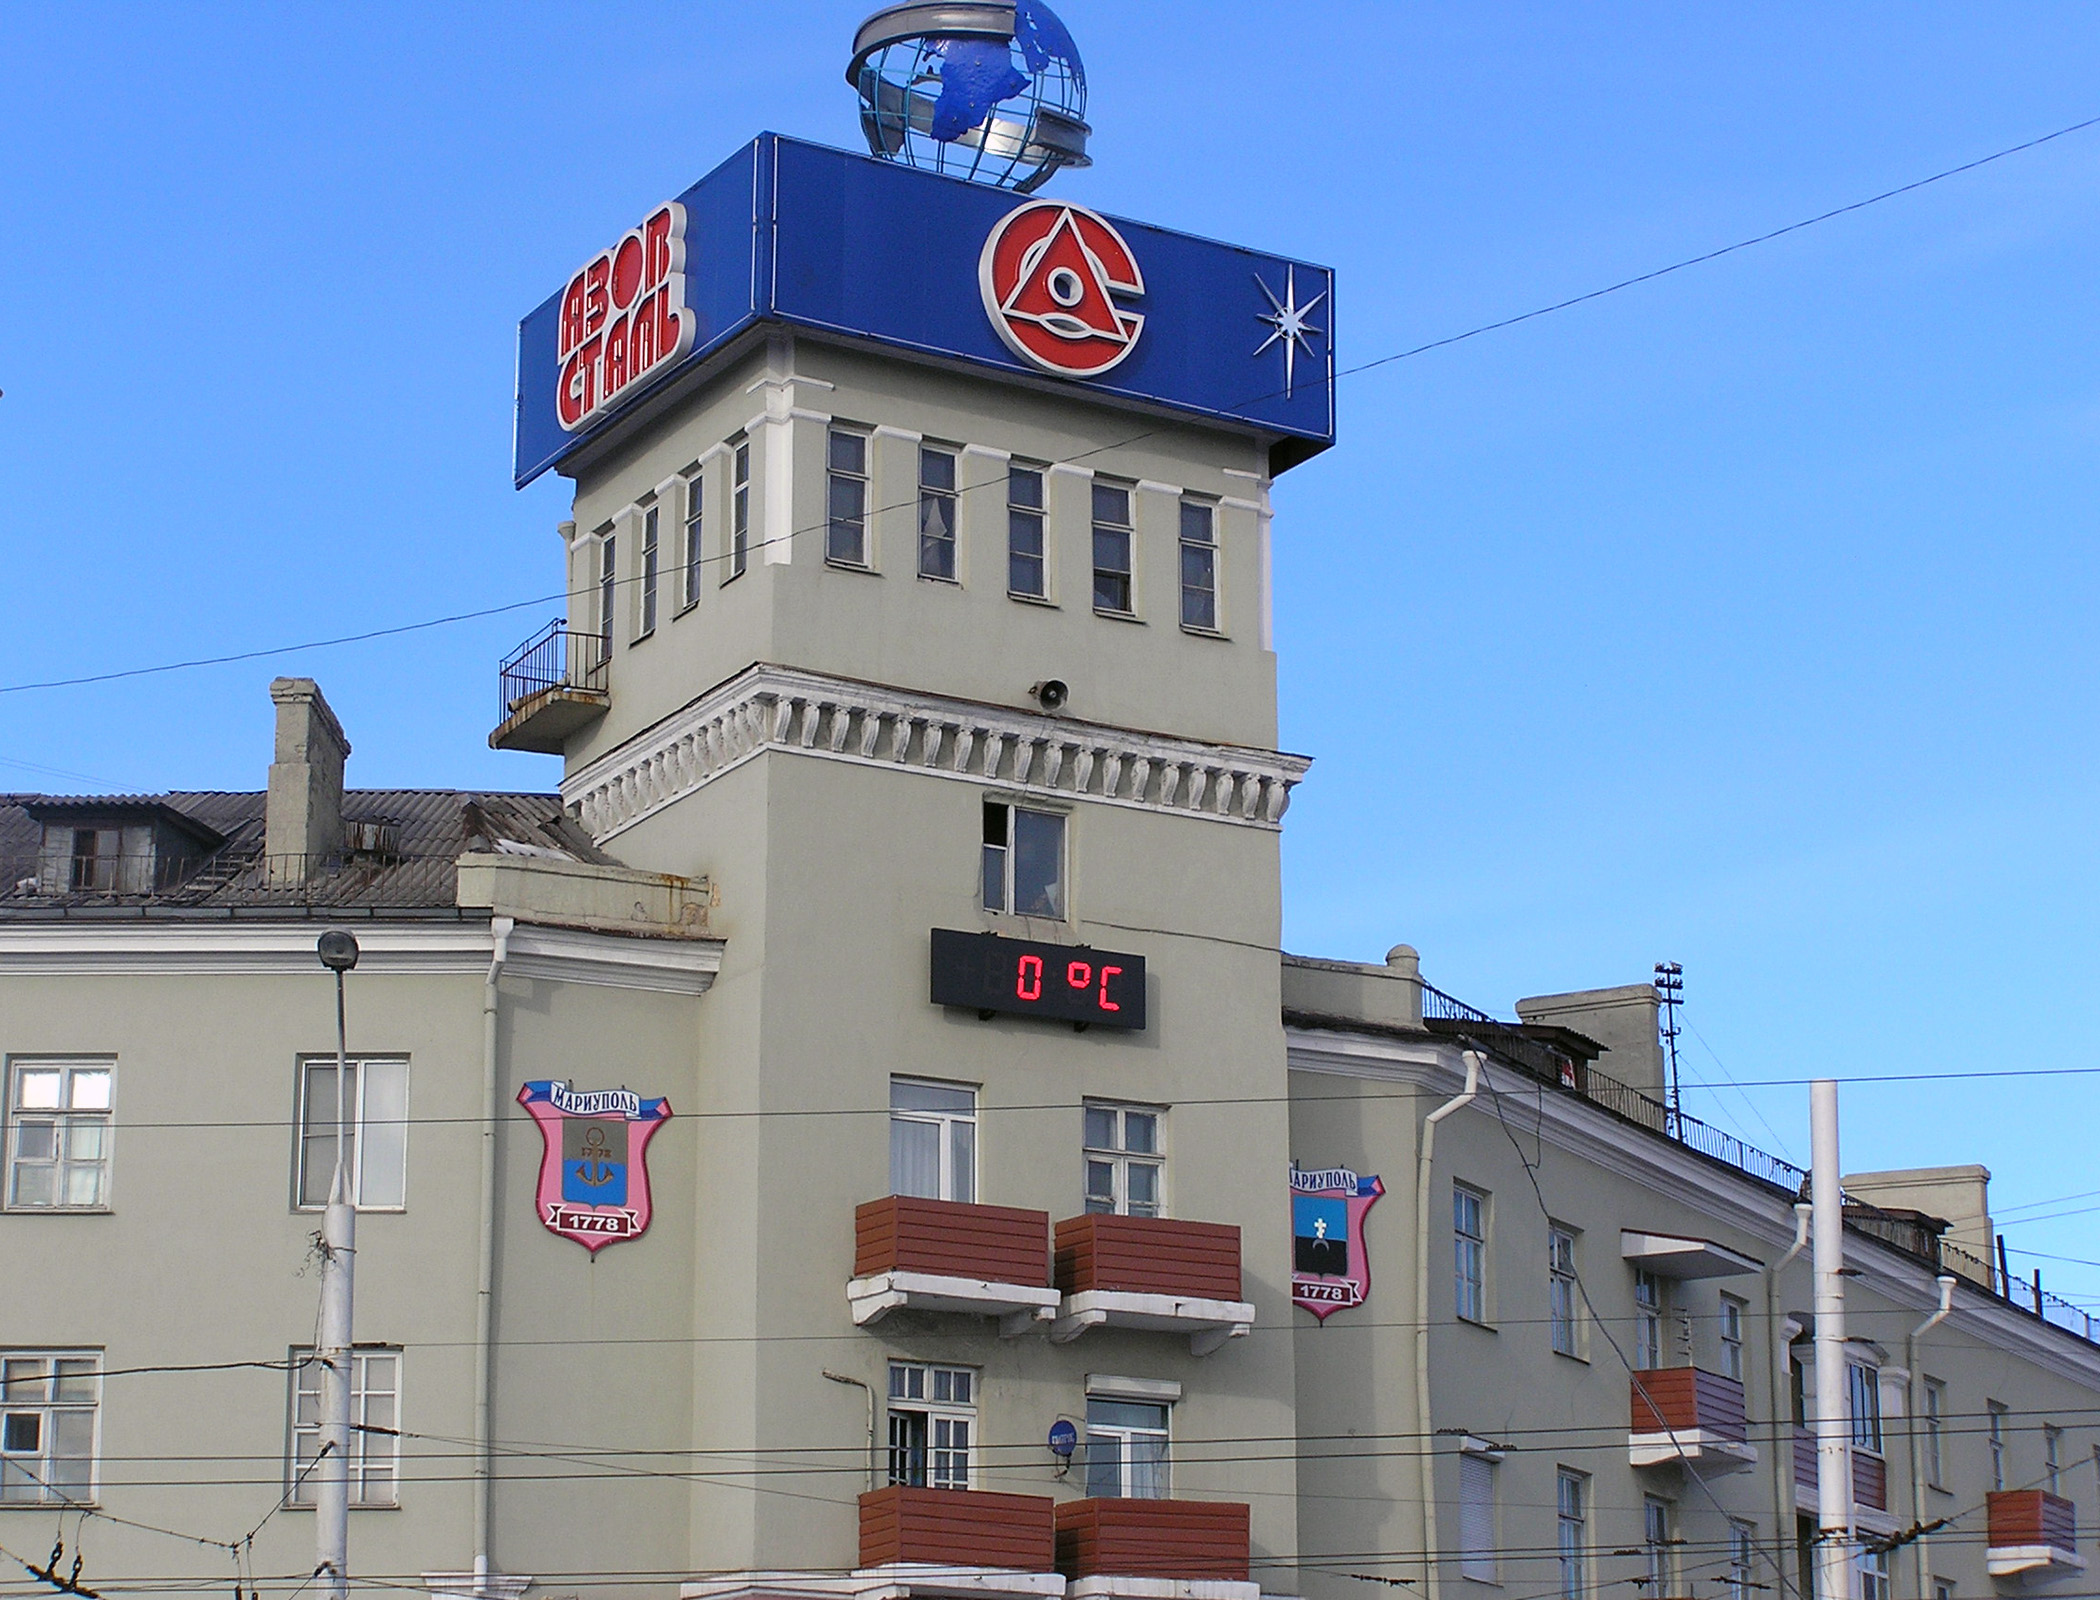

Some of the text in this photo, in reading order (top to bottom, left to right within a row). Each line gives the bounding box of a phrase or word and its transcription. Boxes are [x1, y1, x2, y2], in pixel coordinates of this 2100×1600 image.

[558, 202, 678, 364] АЗОВ
[556, 283, 690, 432] СТАЛЬ
[1017, 955, 1043, 1000] 0
[554, 1088, 637, 1112] МАРИУПОЛЬ
[569, 1216, 619, 1231] 1778
[1300, 1285, 1343, 1300] 1778
